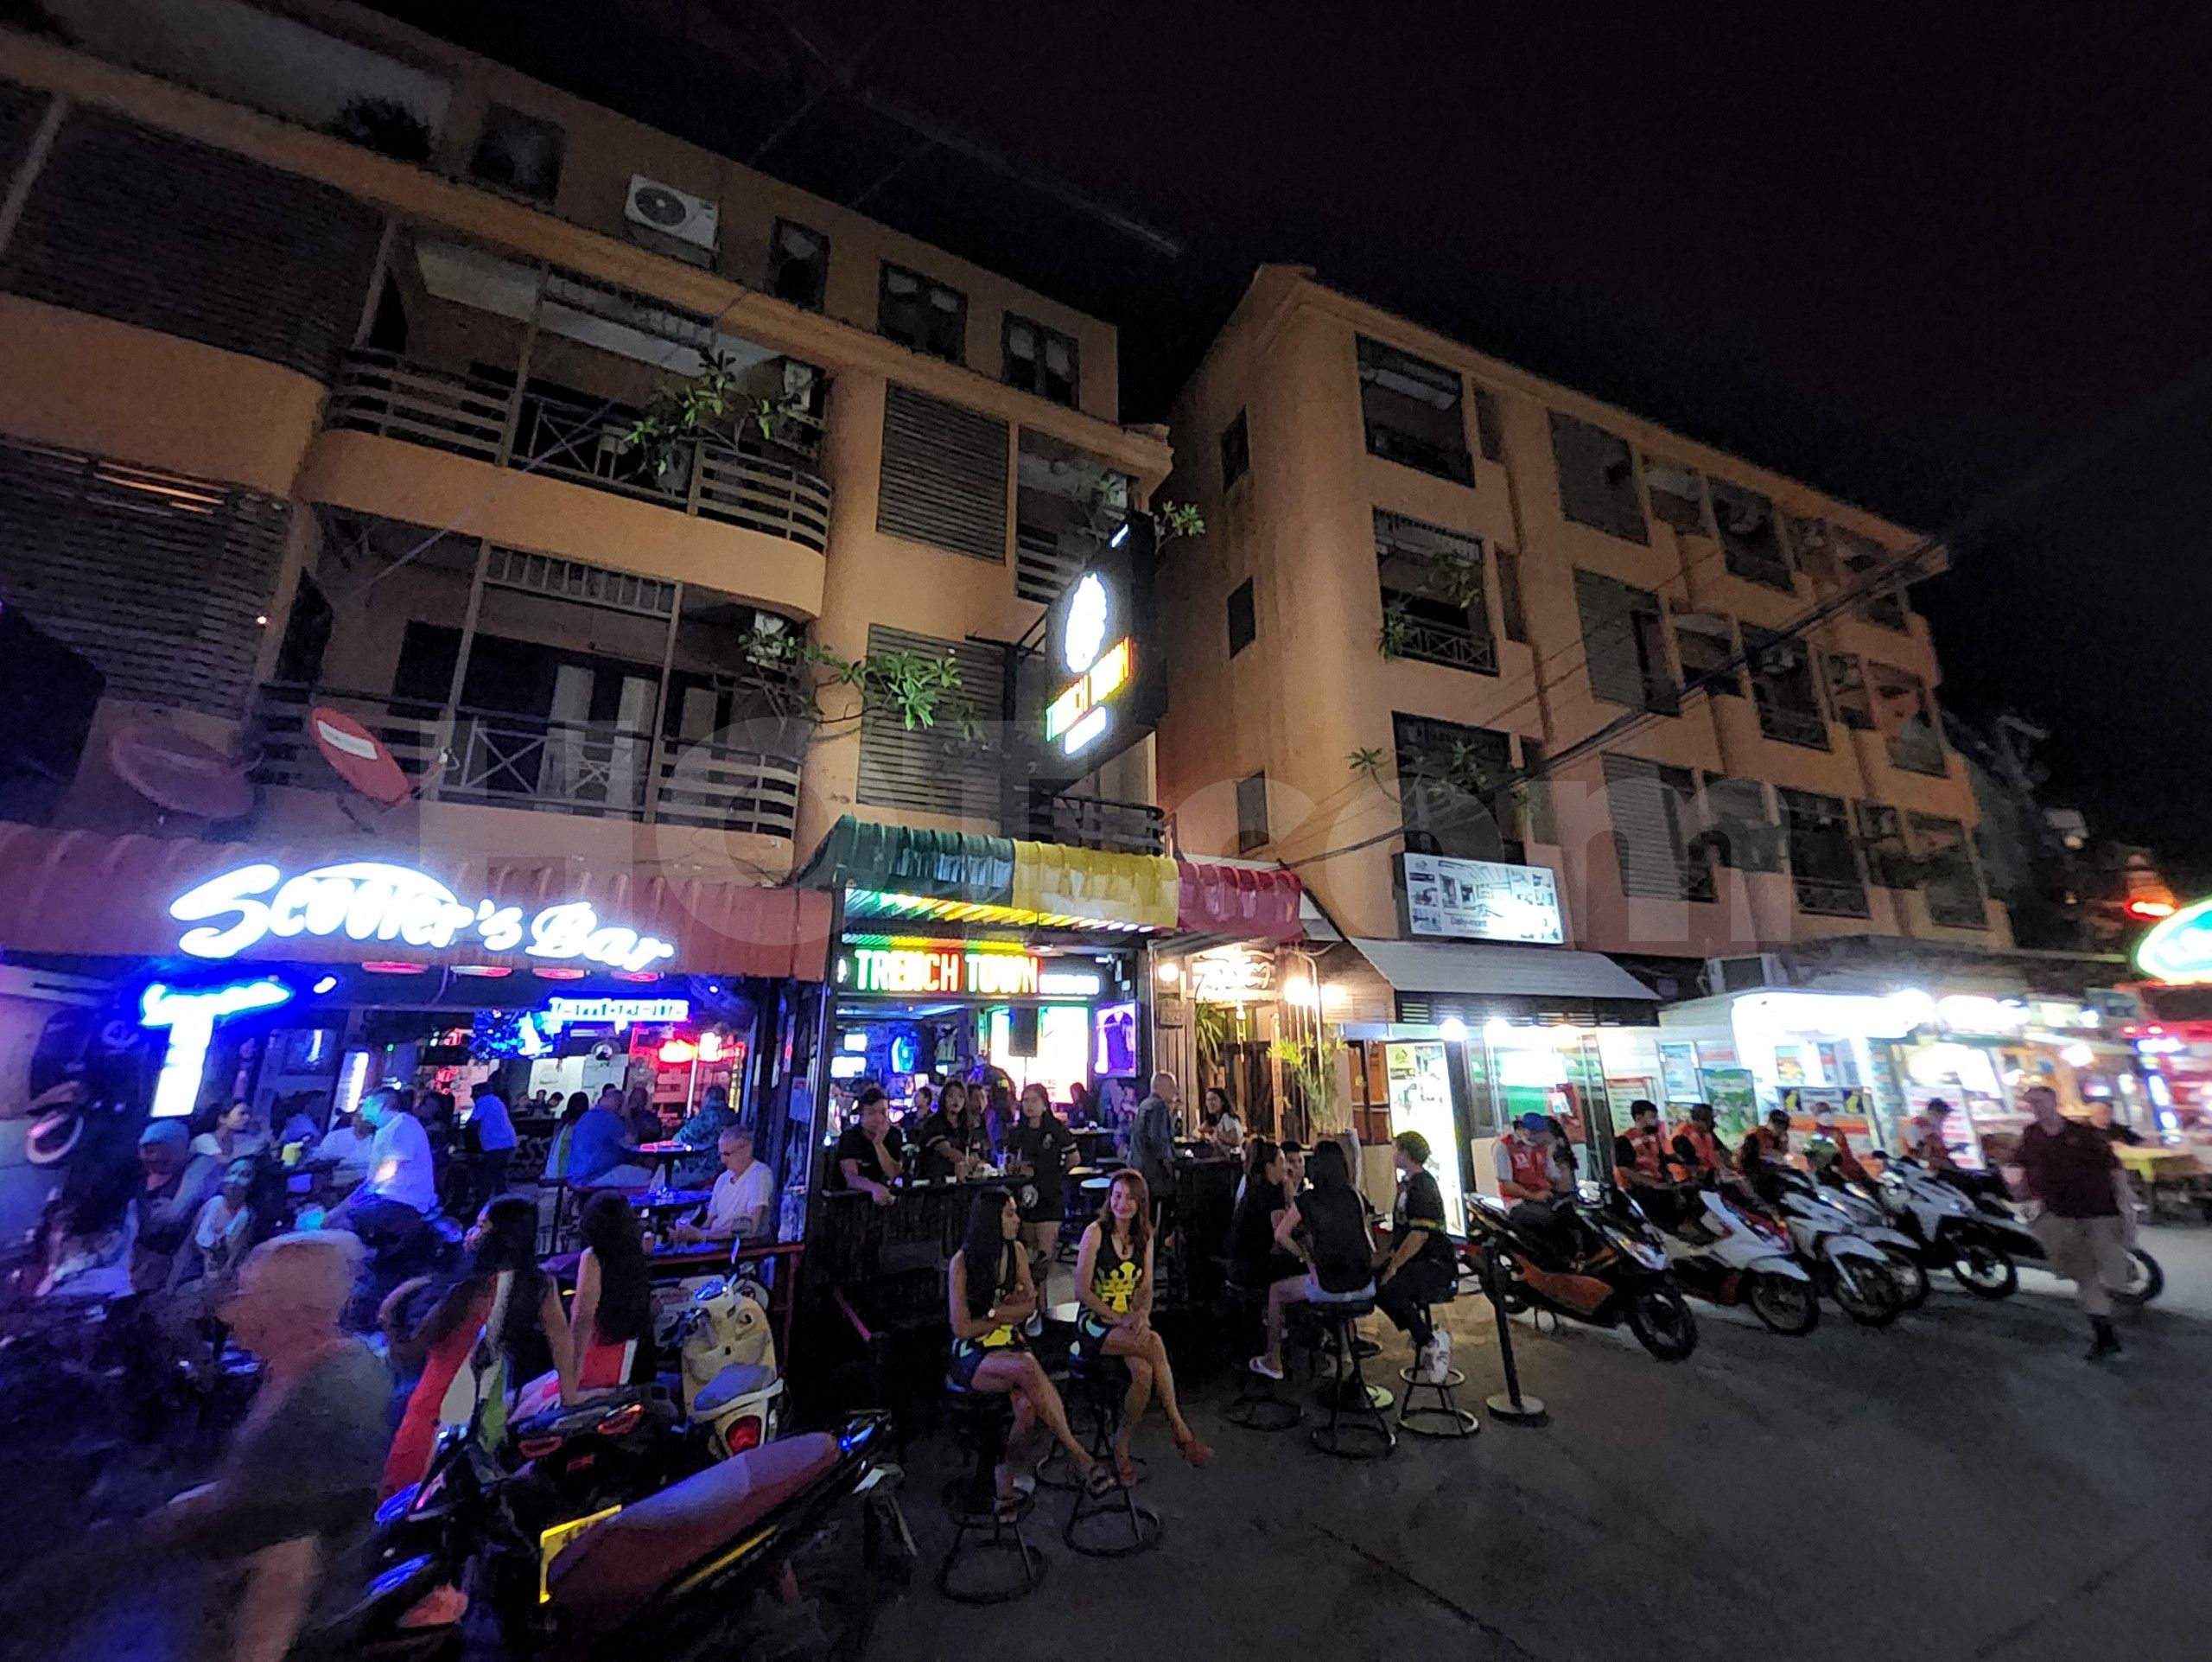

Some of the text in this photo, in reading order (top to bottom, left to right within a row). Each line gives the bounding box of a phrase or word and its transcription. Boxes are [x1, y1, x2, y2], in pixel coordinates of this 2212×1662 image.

[169, 862, 675, 971] Scooter's Bar
[854, 949, 959, 992] TRENCH
[964, 954, 1038, 994] TOWN
